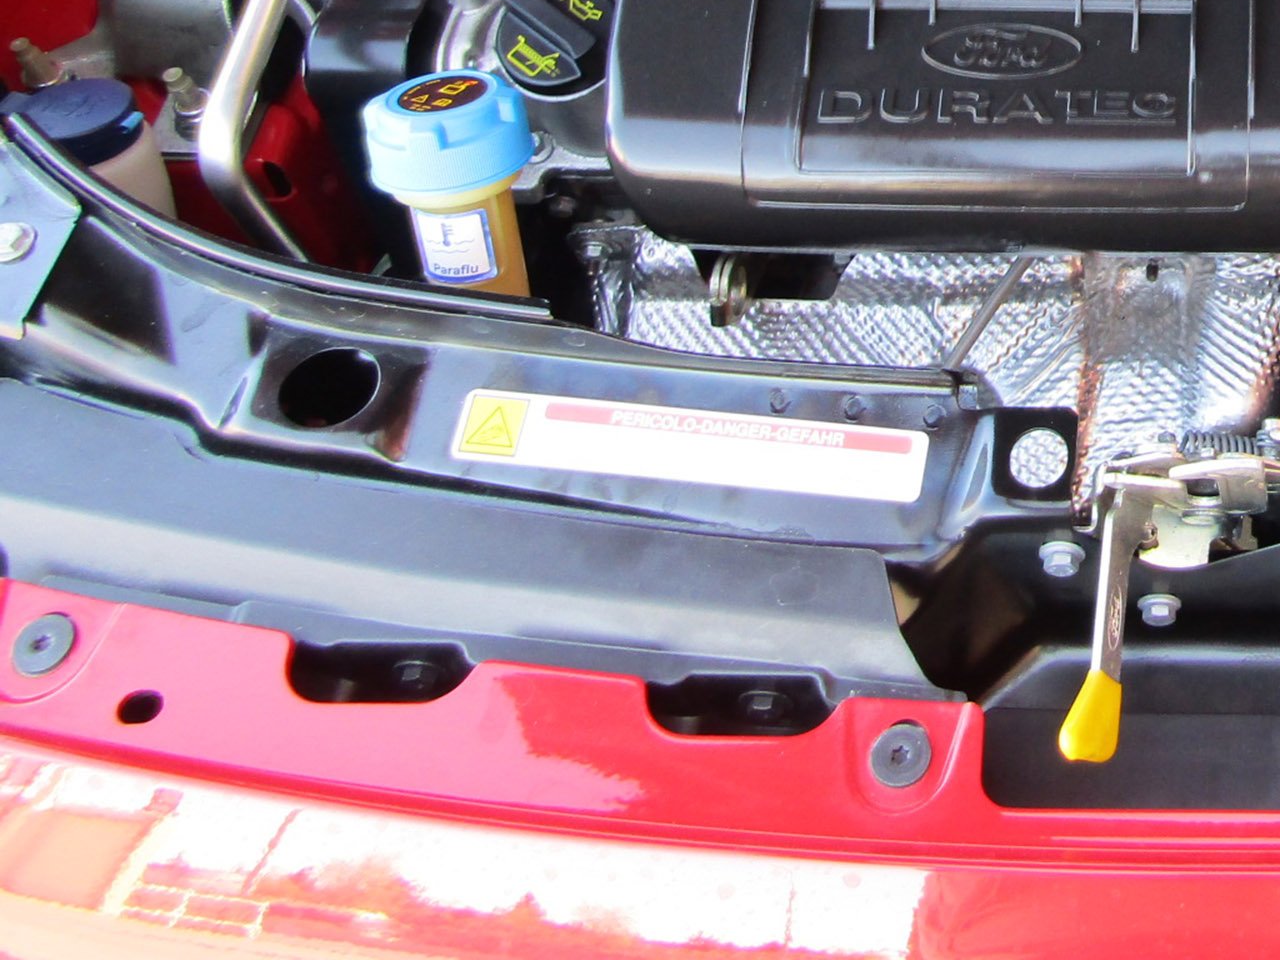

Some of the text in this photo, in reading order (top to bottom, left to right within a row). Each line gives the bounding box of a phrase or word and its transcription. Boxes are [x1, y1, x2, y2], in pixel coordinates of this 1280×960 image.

[953, 28, 1047, 68] Ford
[817, 87, 1177, 125] DURATEC
[433, 263, 479, 275] Paraflu
[611, 409, 845, 448] PERICOLO-DANGER-GEFAHR
